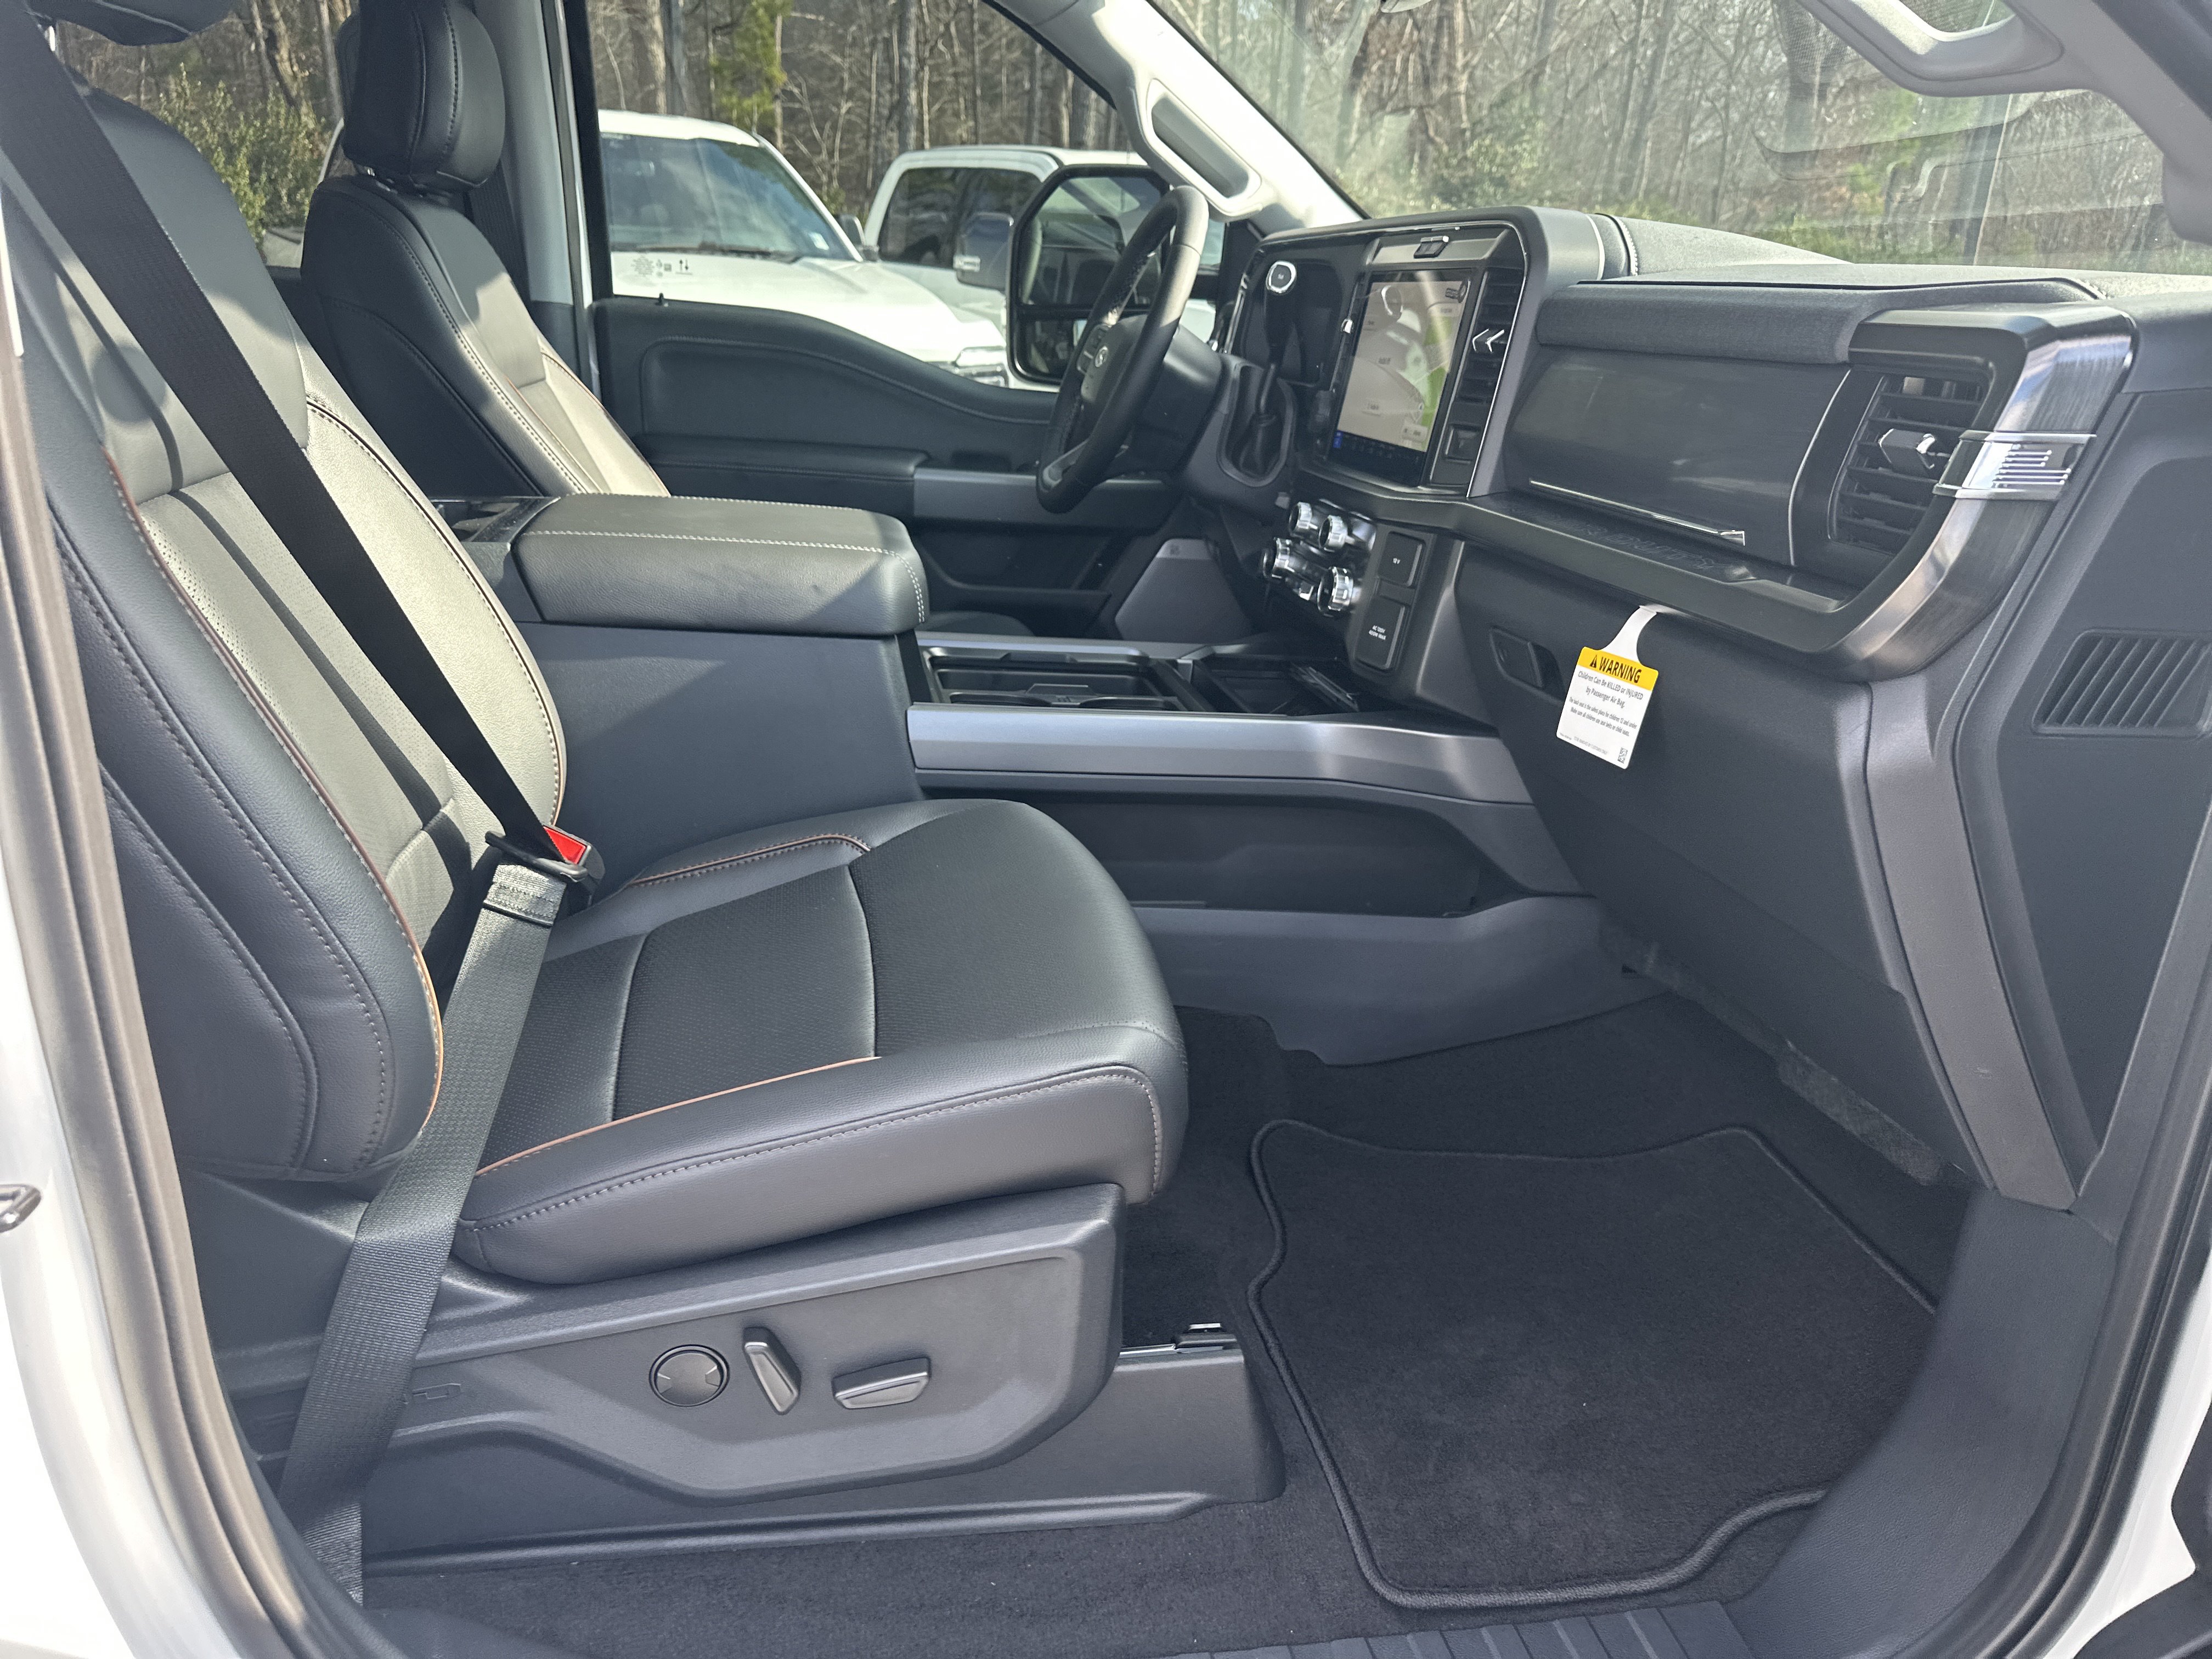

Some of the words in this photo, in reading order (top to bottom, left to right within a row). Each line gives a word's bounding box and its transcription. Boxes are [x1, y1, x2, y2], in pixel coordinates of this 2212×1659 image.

[1599, 656, 1642, 684] WARNING
[1578, 670, 1594, 682] Children
[1606, 681, 1621, 692] KILLED
[1626, 688, 1644, 700] INJURED
[1585, 686, 1591, 695] by
[1591, 688, 1610, 702] Passenger
[1585, 713, 1596, 721] children
[1609, 714, 1620, 722] children
